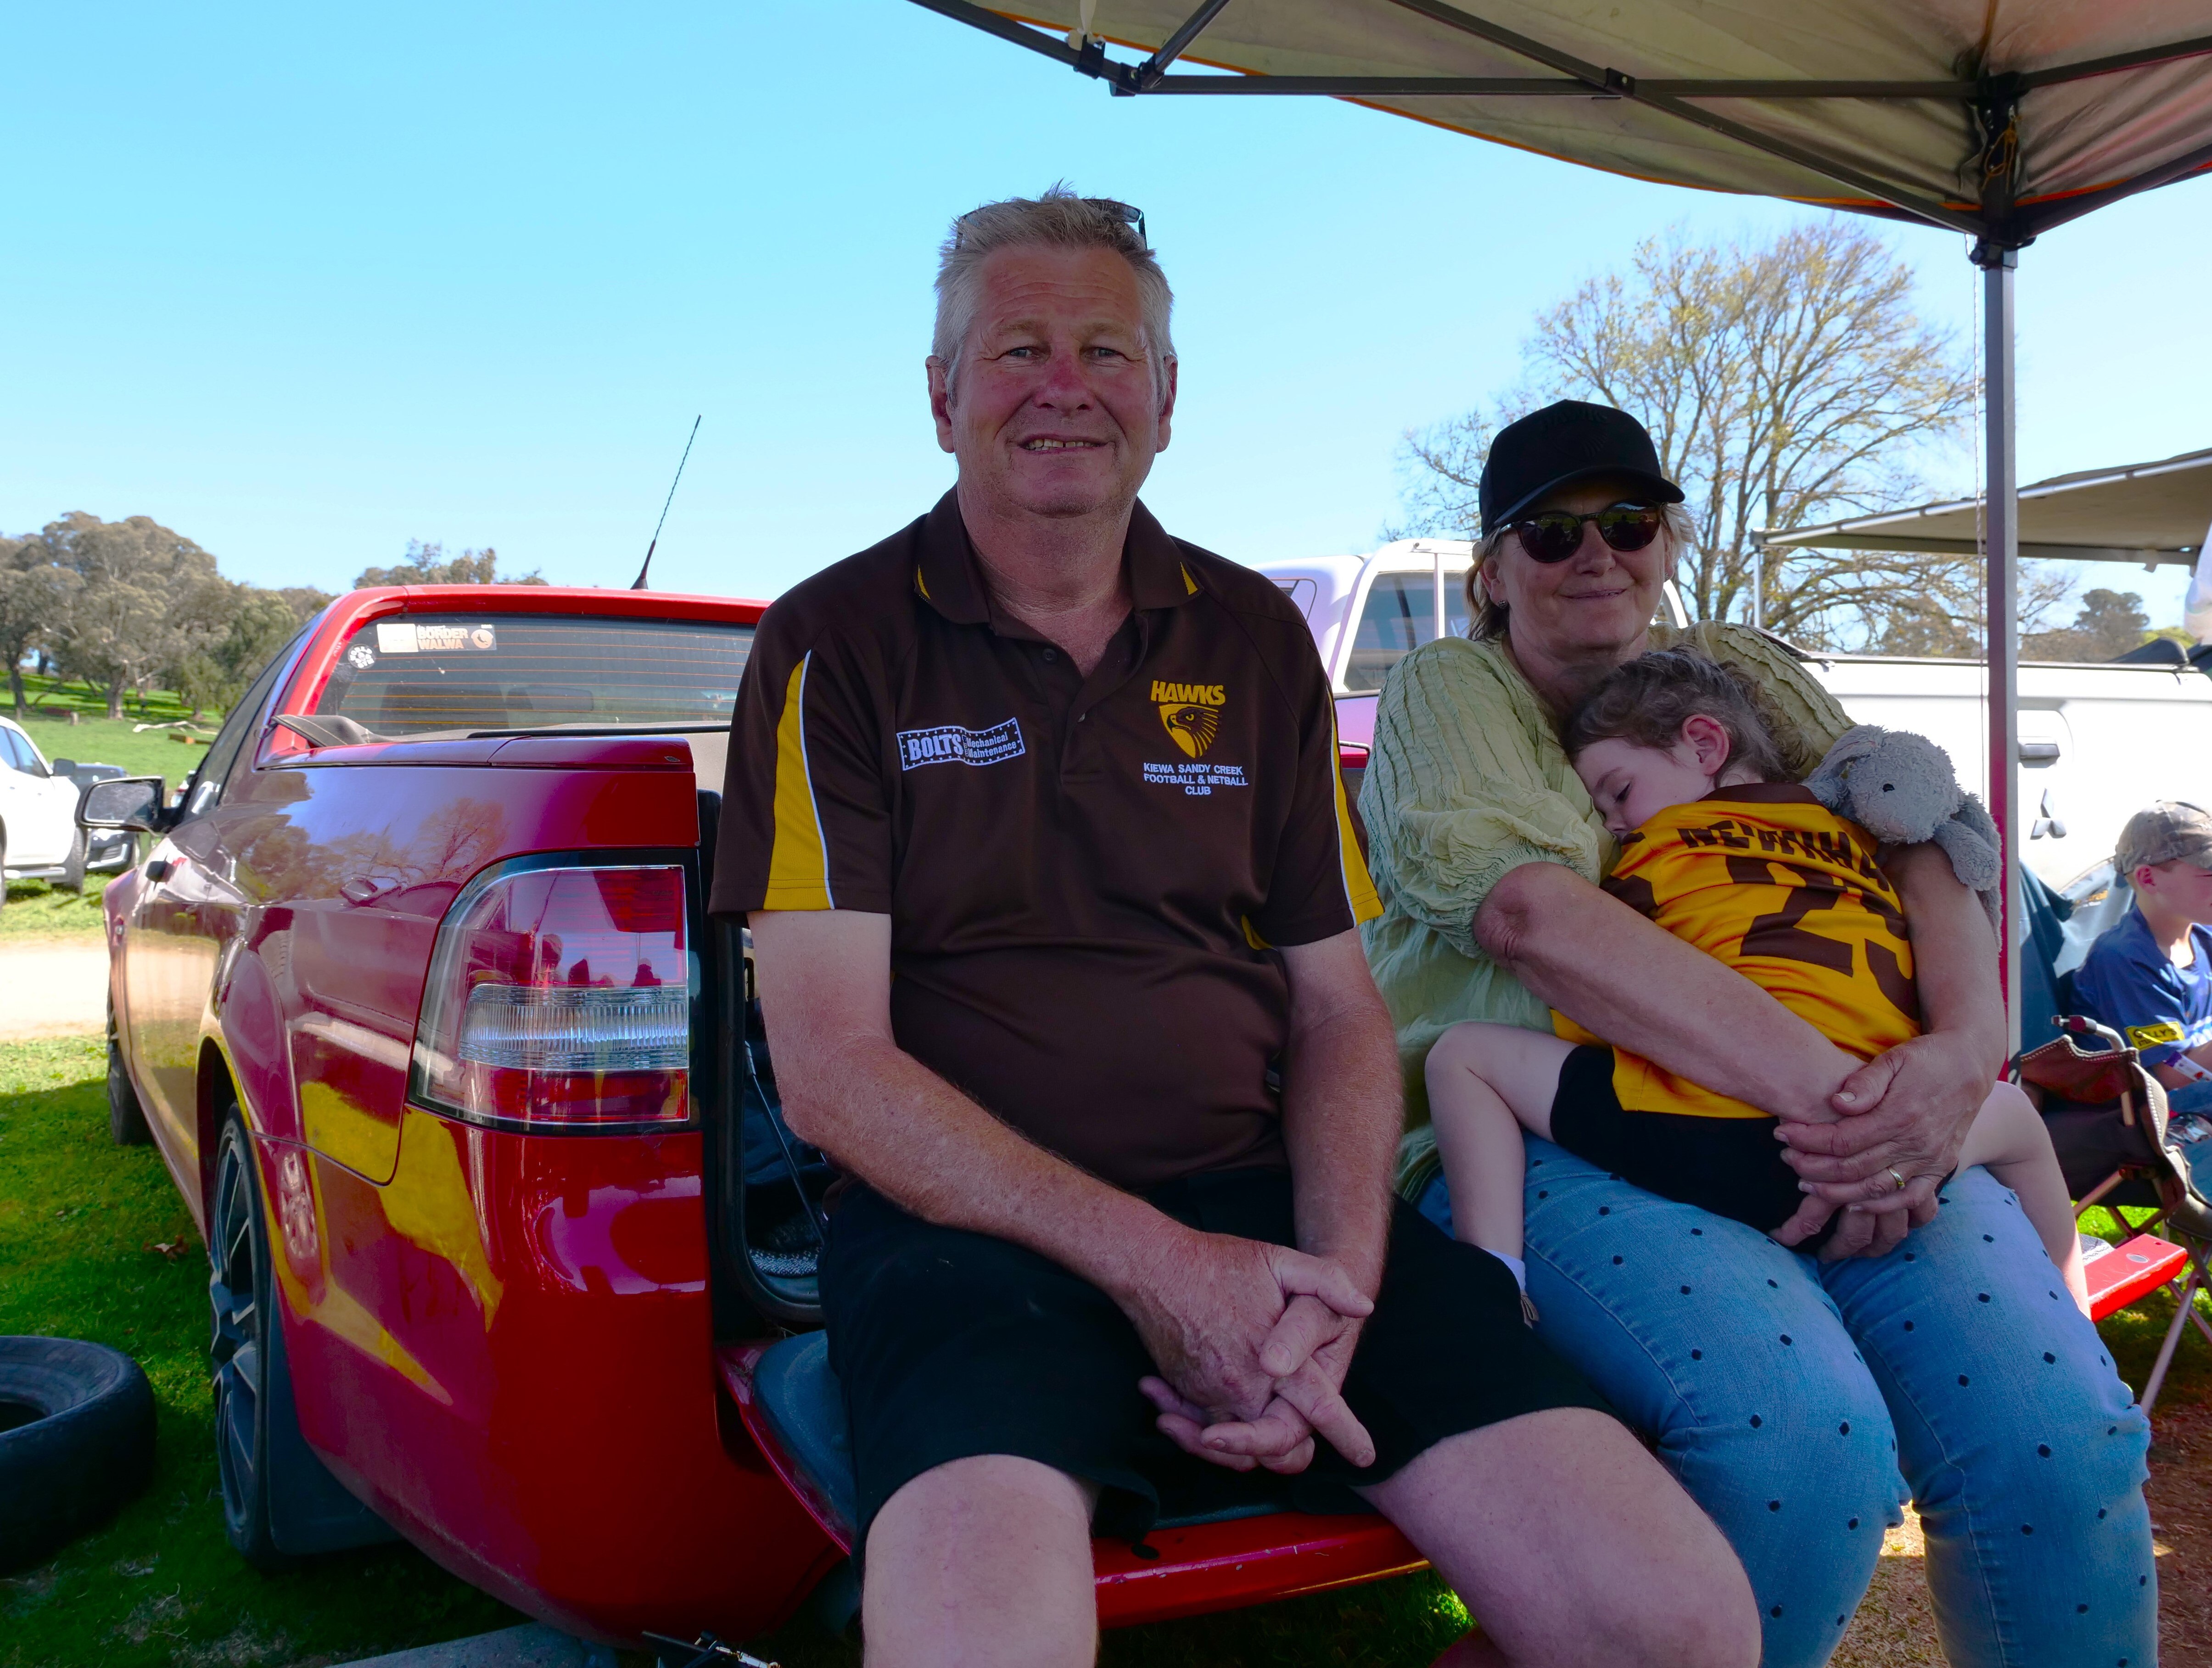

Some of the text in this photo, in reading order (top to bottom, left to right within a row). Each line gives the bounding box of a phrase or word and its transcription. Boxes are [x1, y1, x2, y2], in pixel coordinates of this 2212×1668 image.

[417, 628, 469, 639] BORDER
[418, 639, 465, 650] WALWA
[1151, 680, 1226, 705] HAWKS
[966, 731, 1008, 748] Mechanical
[907, 733, 964, 761] BOLTS
[968, 741, 1017, 758] Maintenance
[1143, 762, 1243, 776] KIEWA SANDY CREEK
[1143, 773, 1249, 786] FOOTBALL & NETBALL
[1185, 786, 1212, 795] CLUB
